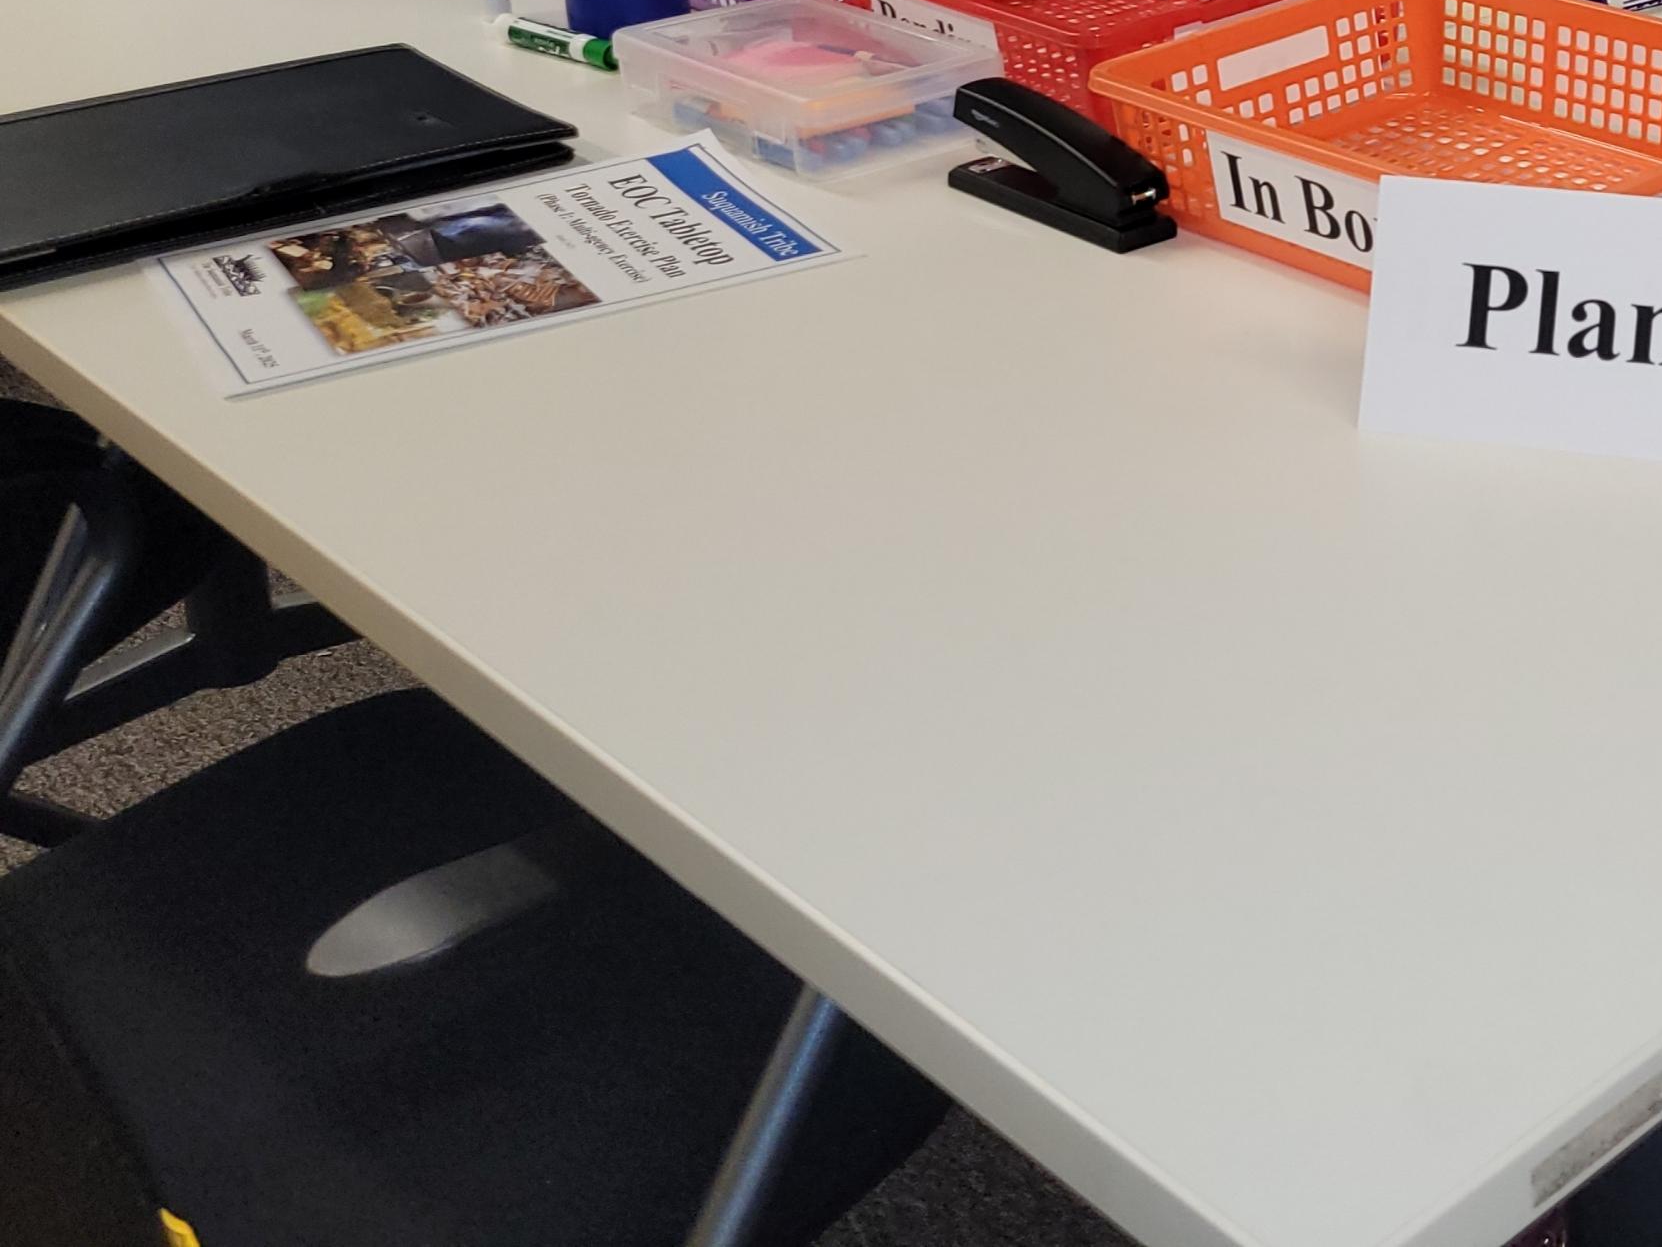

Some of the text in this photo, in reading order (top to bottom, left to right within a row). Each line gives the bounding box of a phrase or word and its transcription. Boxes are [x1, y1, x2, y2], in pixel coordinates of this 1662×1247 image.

[565, 182, 687, 279] Tornado Exercise Plan
[607, 173, 736, 268] EOC Tabletop
[702, 189, 800, 258] Suquamish Tribe
[1219, 150, 1378, 253] In Bo
